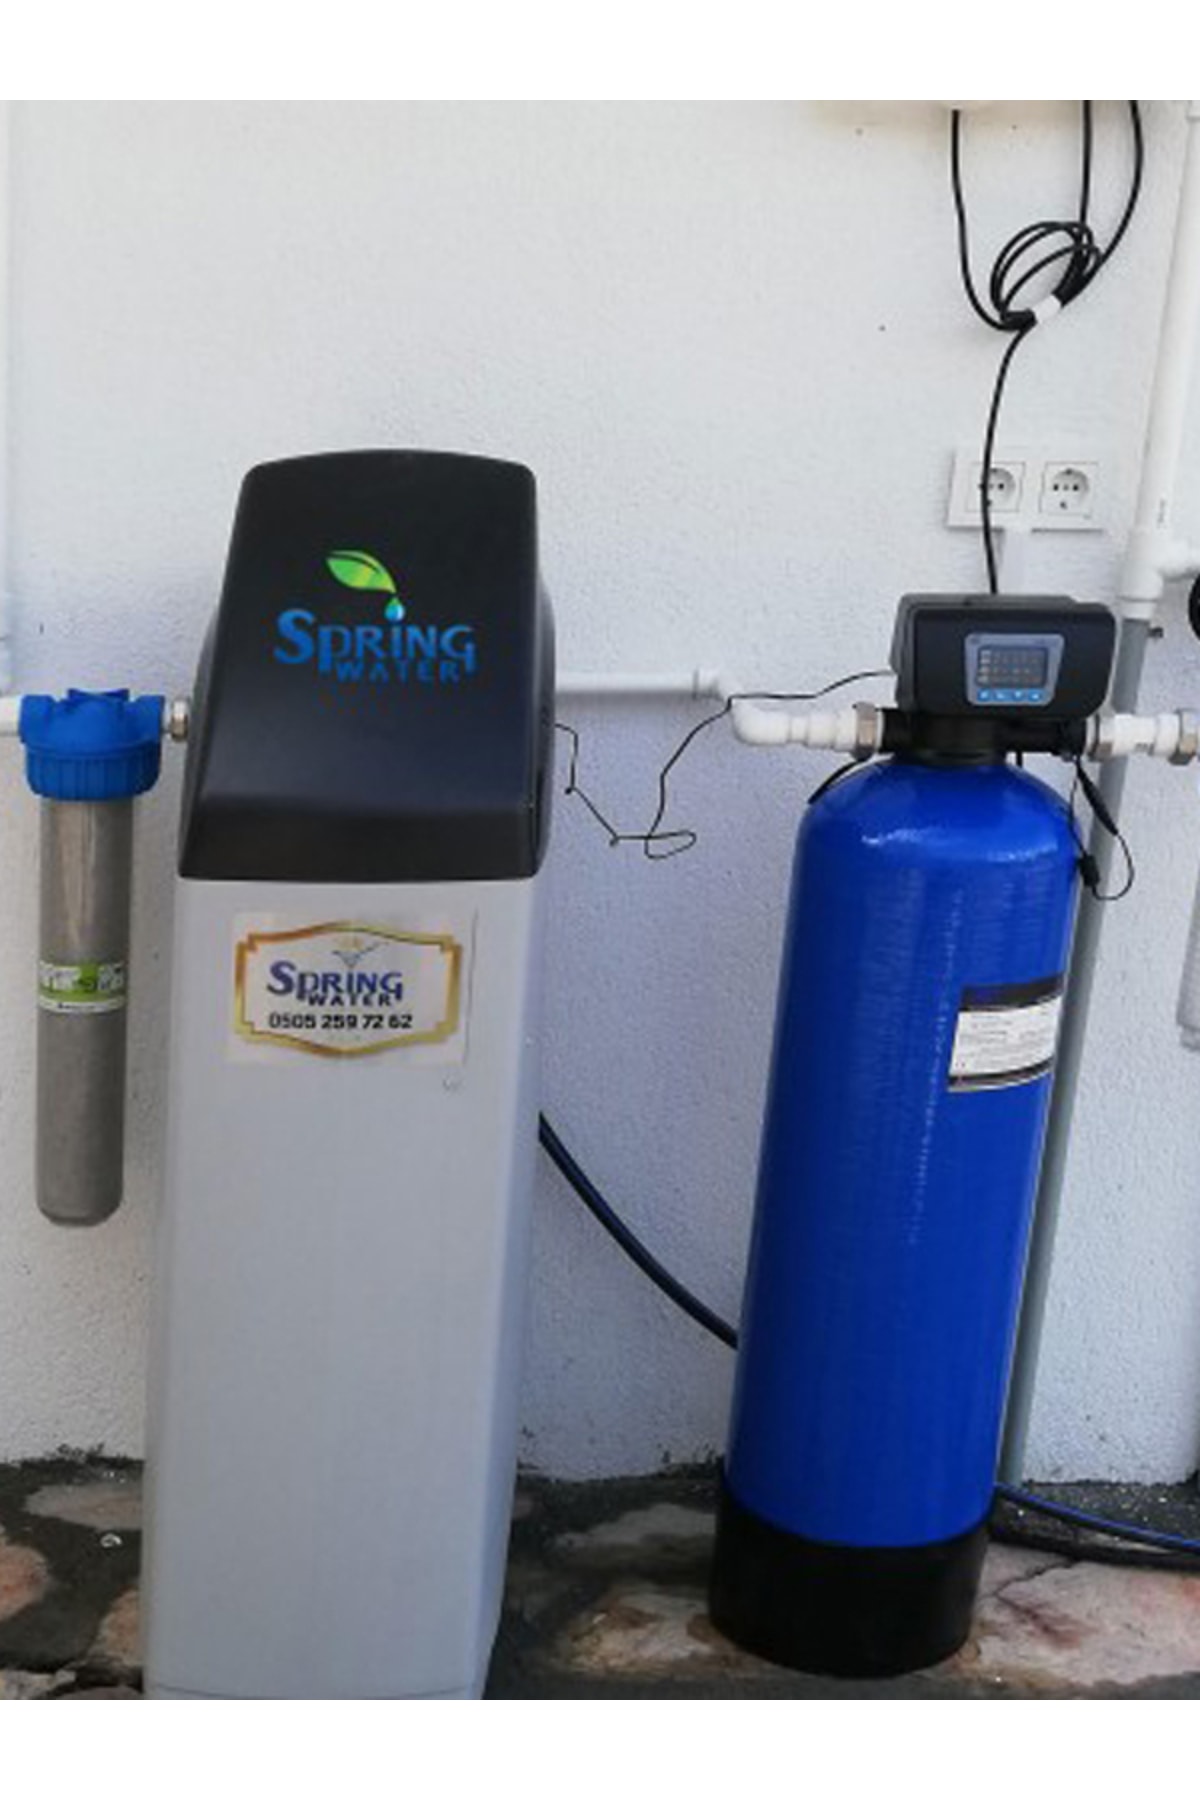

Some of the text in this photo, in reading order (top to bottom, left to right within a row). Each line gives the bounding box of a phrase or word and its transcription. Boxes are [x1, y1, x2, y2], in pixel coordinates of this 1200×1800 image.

[336, 660, 459, 683] WATER
[266, 960, 403, 1001] SPRING
[308, 993, 391, 1006] WATER
[269, 1012, 316, 1029] 0505
[321, 1014, 357, 1029] 259
[362, 1014, 384, 1029] 72
